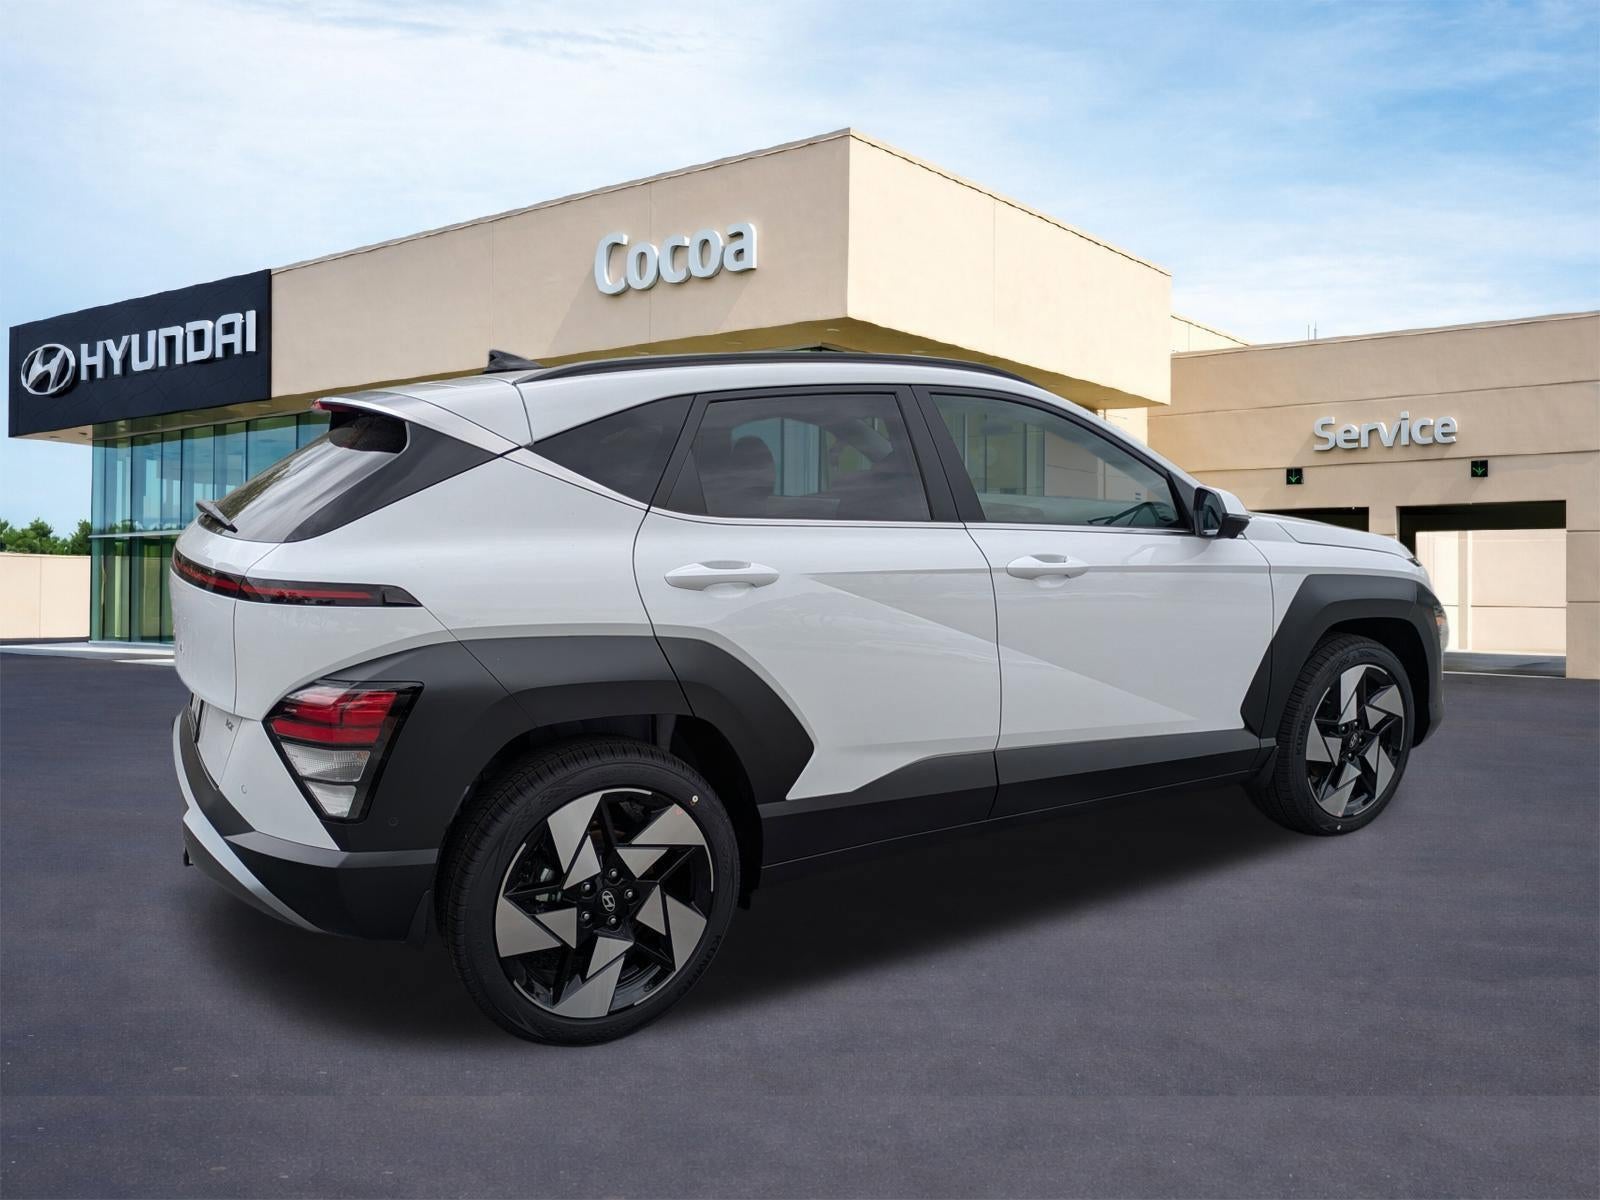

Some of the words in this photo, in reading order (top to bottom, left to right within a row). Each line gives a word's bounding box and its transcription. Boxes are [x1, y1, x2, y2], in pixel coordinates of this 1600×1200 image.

[594, 223, 757, 295] Cocoa
[80, 310, 257, 381] HYUNDAI
[1313, 411, 1458, 451] Service
